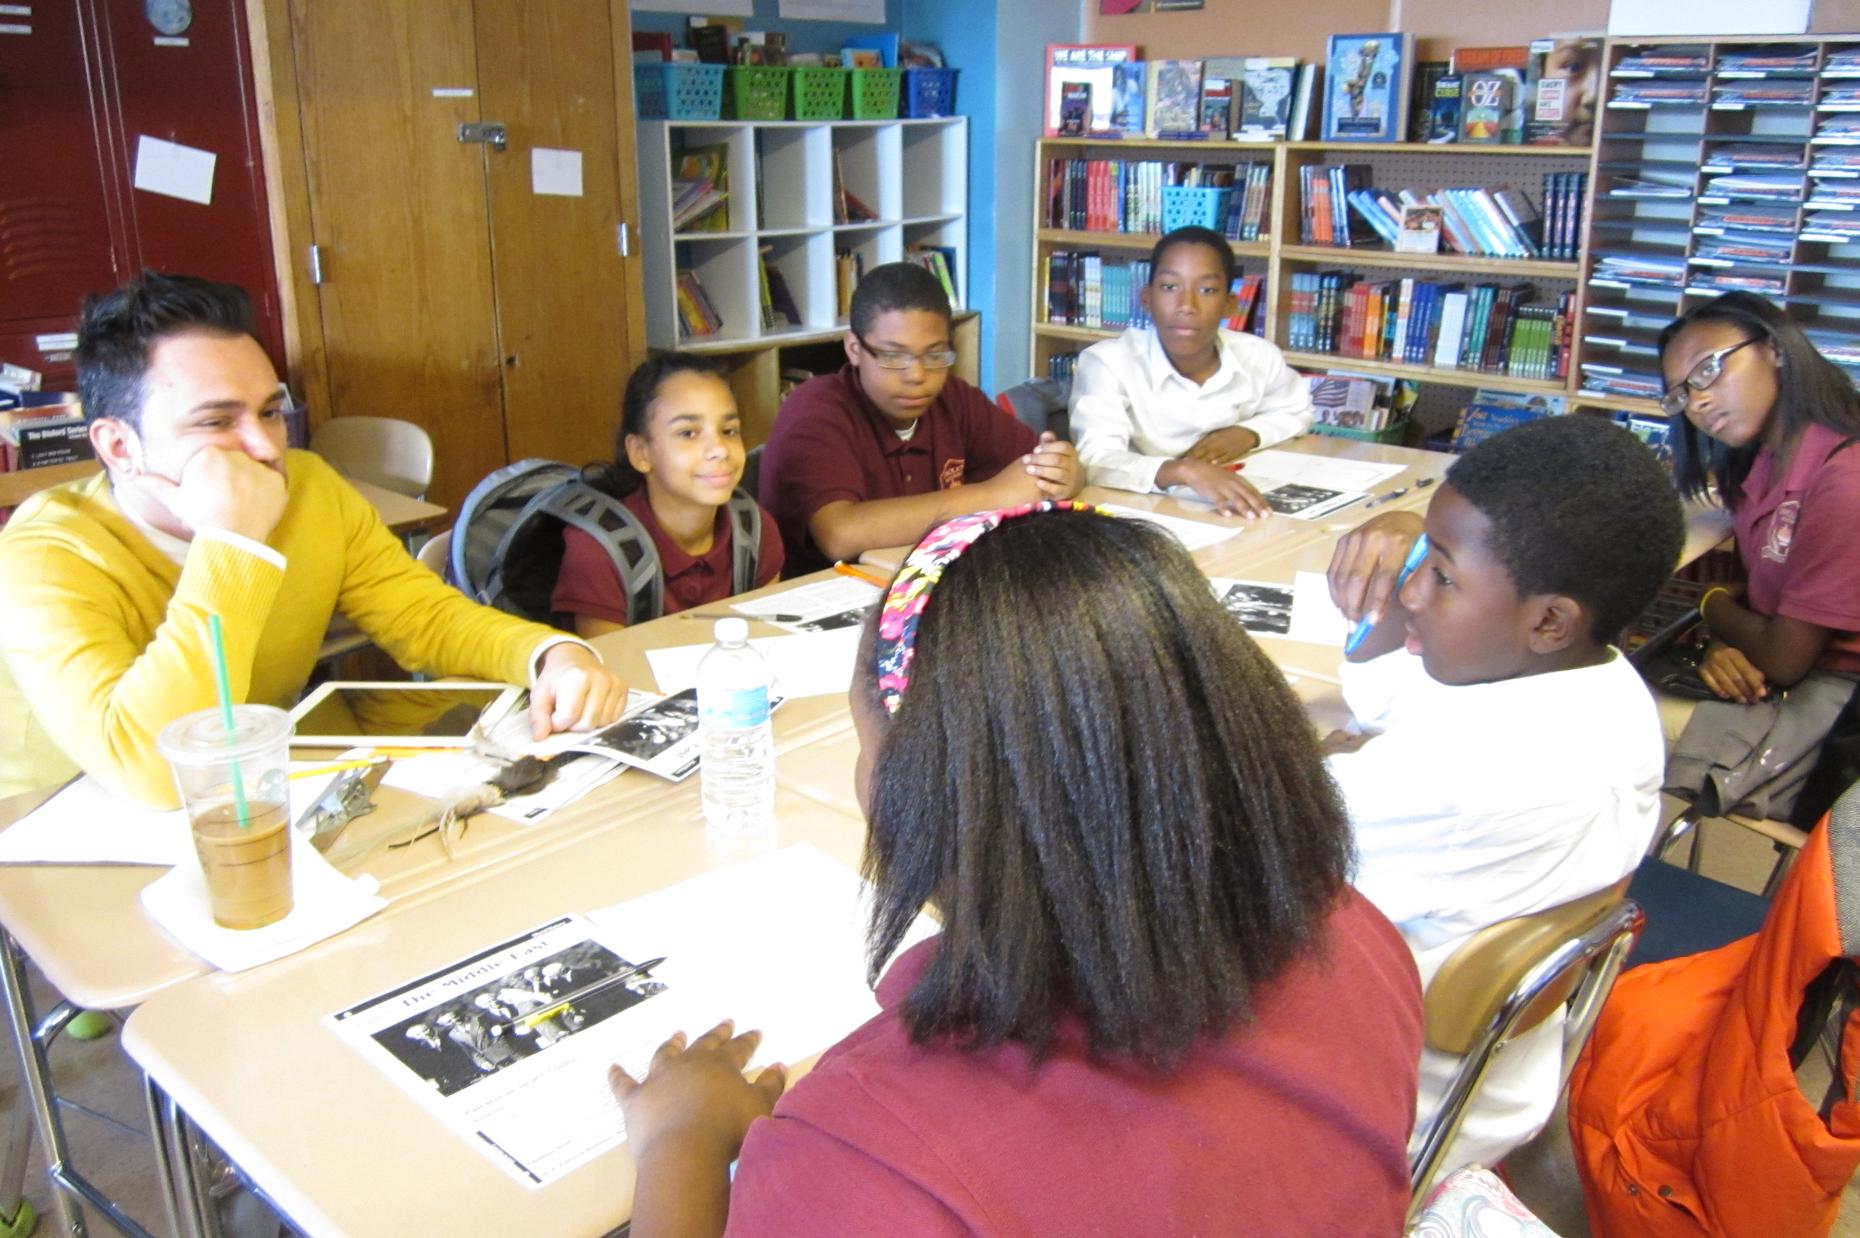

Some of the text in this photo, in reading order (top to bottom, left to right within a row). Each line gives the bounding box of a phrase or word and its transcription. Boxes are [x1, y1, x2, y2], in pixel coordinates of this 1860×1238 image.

[1472, 80, 1501, 106] OZ
[28, 431, 41, 440] The
[402, 941, 548, 1007] The Middle East
